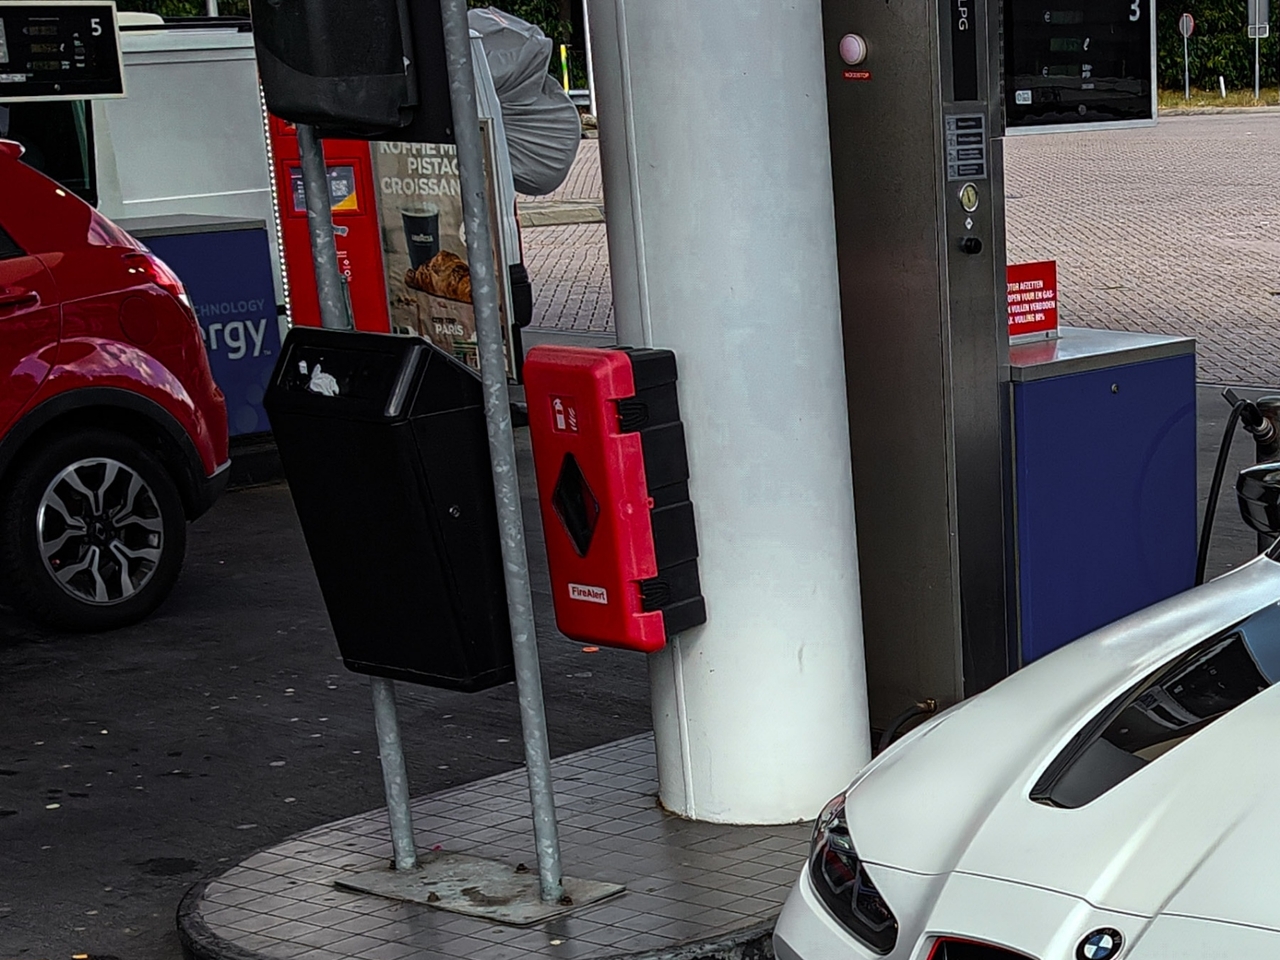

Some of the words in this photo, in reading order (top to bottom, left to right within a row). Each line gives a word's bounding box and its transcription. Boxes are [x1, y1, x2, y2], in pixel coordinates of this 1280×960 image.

[957, 0, 968, 31] LPG
[1129, 0, 1140, 21] 3
[90, 18, 102, 36] 5
[380, 142, 437, 155] KOFFIE
[440, 144, 457, 156] M
[381, 177, 461, 196] CROISSAN
[1030, 301, 1055, 311] VERBODEN
[435, 323, 464, 336] PARIS
[571, 586, 606, 601] FireAlert
